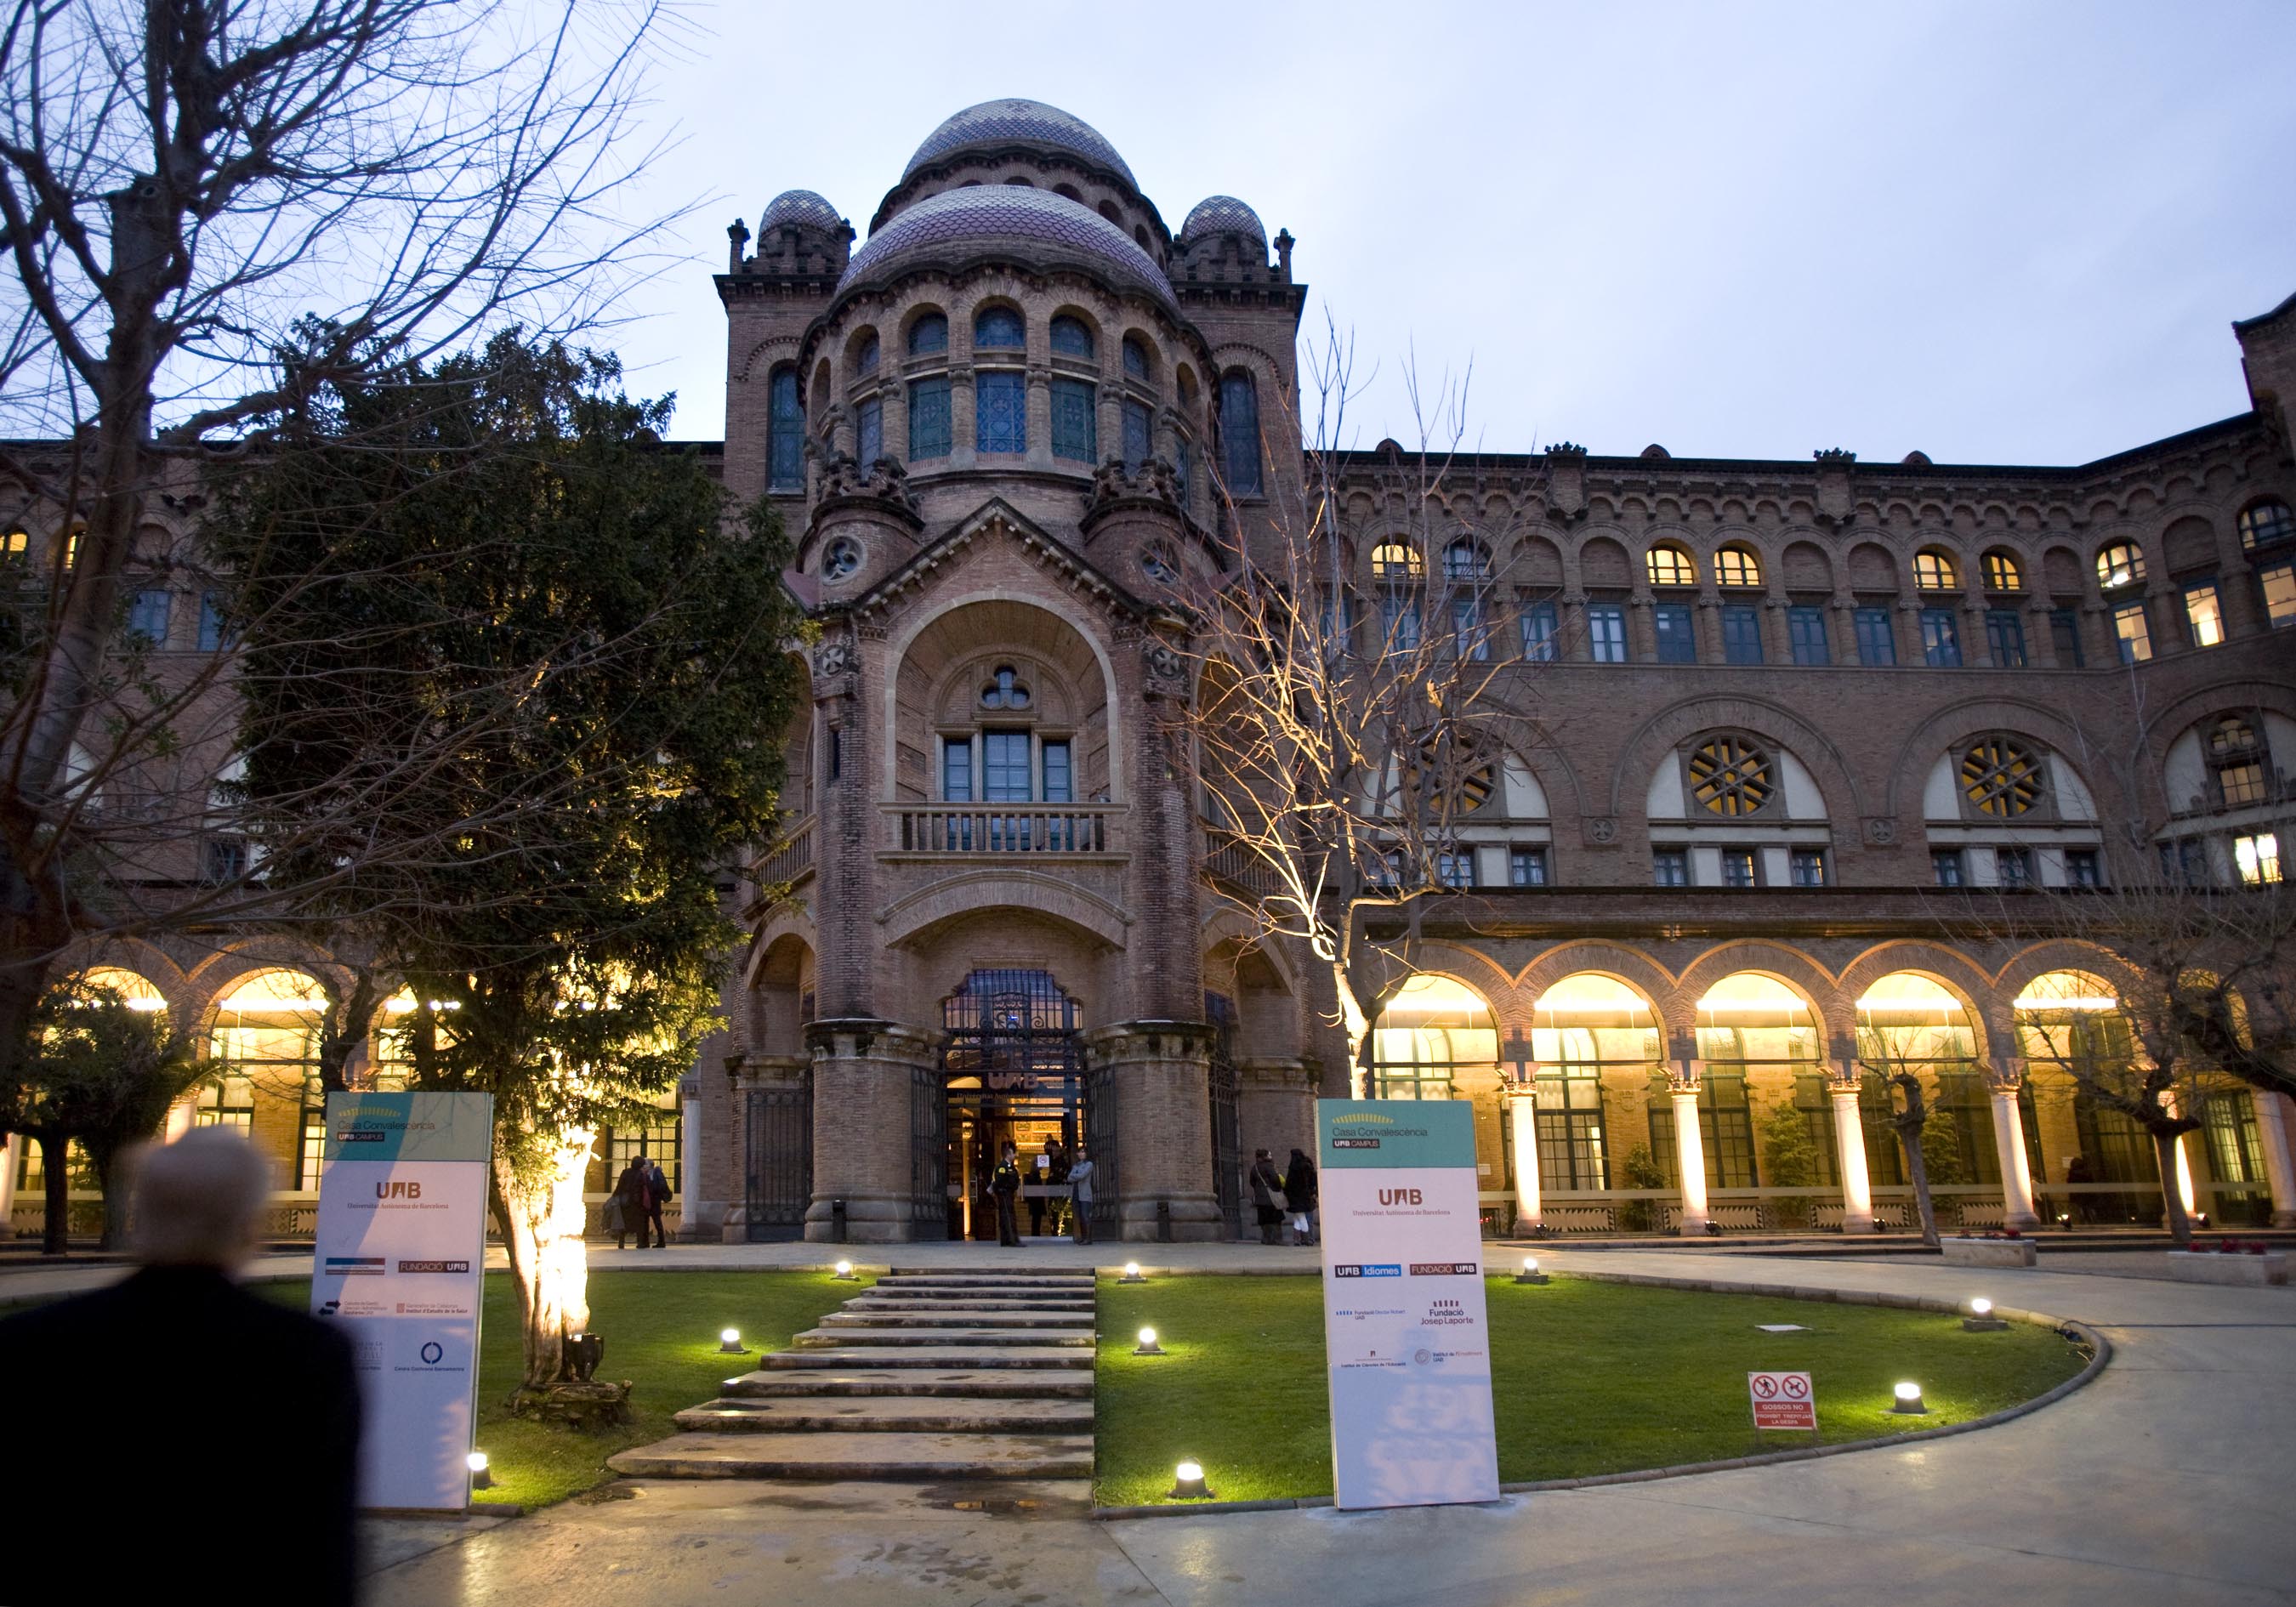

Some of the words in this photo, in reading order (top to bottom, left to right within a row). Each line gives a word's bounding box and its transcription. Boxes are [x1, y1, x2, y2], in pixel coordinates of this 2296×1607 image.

[338, 1121, 361, 1130] Casa
[1333, 1127, 1355, 1137] Casa
[1358, 1127, 1428, 1137] Convalescència
[376, 1182, 421, 1199] UAB
[1378, 1189, 1423, 1206] UAB
[446, 1263, 467, 1271] UAB
[1338, 1267, 1360, 1275] UAB
[1364, 1266, 1400, 1275] Idiomes
[1455, 1264, 1475, 1273] UAB
[1429, 1309, 1464, 1317] Fundació
[1421, 1317, 1443, 1326] Josep
[1445, 1316, 1474, 1326] Laporte
